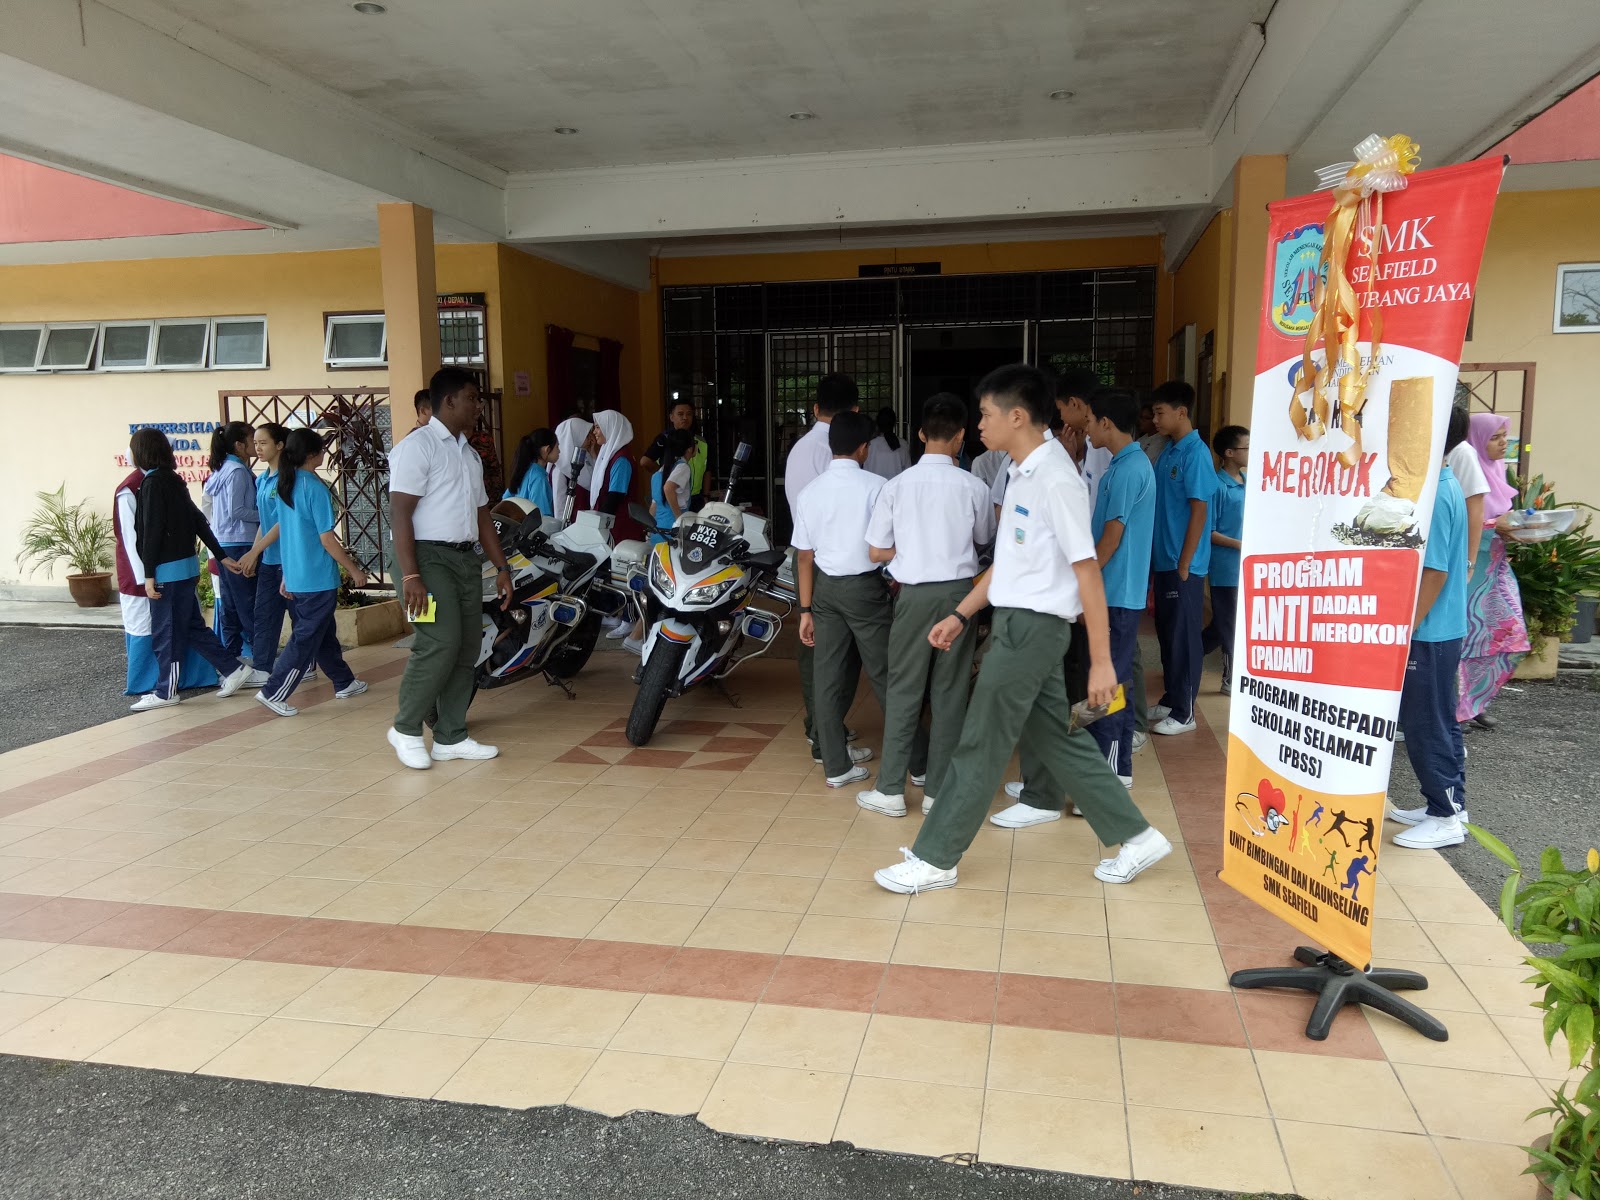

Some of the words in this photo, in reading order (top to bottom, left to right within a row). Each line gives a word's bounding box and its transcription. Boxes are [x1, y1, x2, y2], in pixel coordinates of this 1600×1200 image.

[1358, 215, 1436, 257] SMK
[1351, 257, 1438, 284] SEAFIELD
[1356, 286, 1421, 308] UBANG
[1423, 282, 1472, 303] JAYA
[1261, 450, 1378, 498] MEROKOK
[690, 532, 717, 549] 6842
[697, 525, 718, 538] WXR
[1253, 557, 1363, 590] PROGRAM
[1250, 595, 1310, 643] ANTI
[1312, 595, 1377, 615] DADAH
[1311, 622, 1409, 645] MEROKOK
[1239, 675, 1300, 713] PROGRAM
[1301, 696, 1396, 742] BERSEPADU
[1251, 706, 1301, 742] SEKOLAH
[1303, 726, 1377, 767] SELAMAT
[1229, 829, 1246, 853] UNIT
[1246, 840, 1290, 881] BIMBINGAN
[1291, 866, 1308, 892] DAN
[1309, 877, 1370, 927] KAUNSELING
[1263, 874, 1281, 898] SMK
[1282, 887, 1318, 923] SEAFIELD
